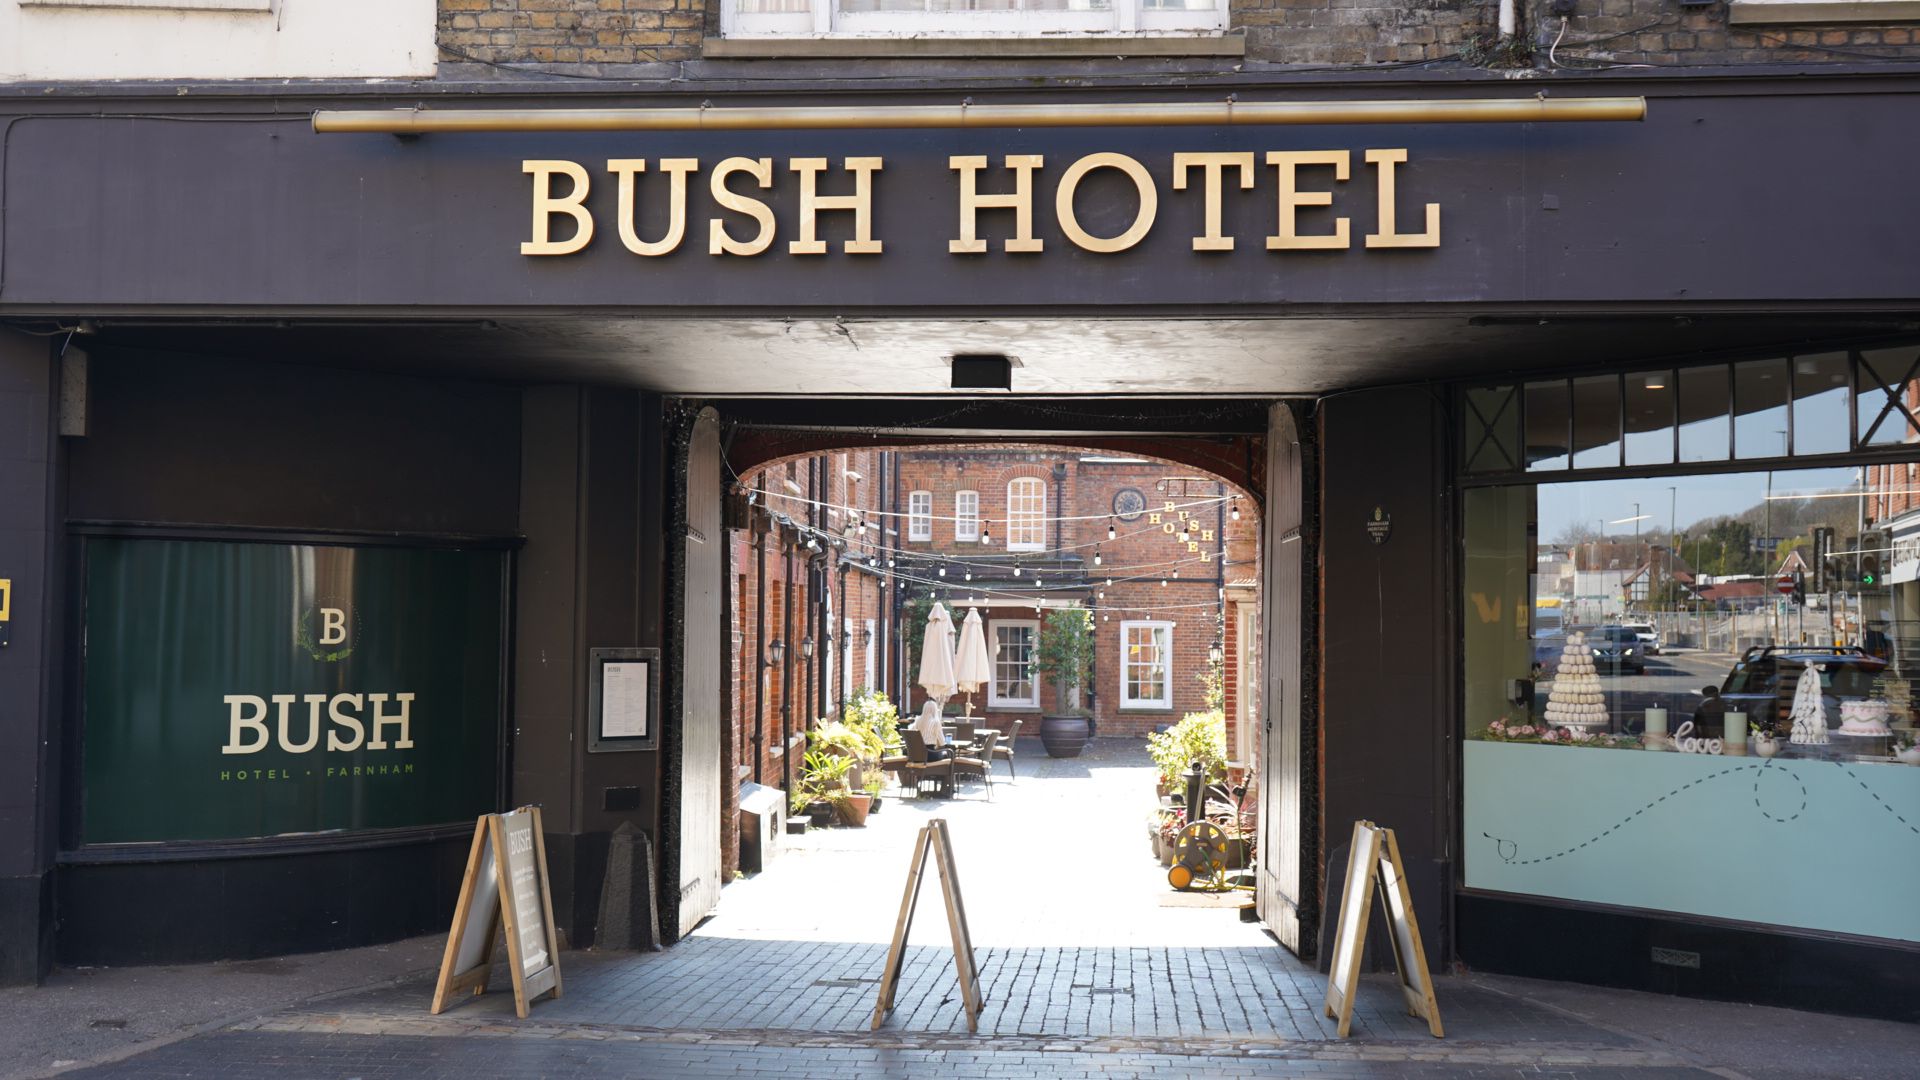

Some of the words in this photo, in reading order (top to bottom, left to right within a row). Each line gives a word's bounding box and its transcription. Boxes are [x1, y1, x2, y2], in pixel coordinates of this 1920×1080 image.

[520, 156, 883, 256] BUSH
[949, 148, 1440, 253] HOTEL
[1149, 513, 1211, 562] HOTEL
[1163, 501, 1214, 541] BUSH
[319, 607, 346, 645] B
[222, 692, 415, 754] BUSH
[1673, 720, 1723, 755] love
[221, 769, 290, 781] HOTEL
[327, 764, 414, 777] FARNHAM
[509, 827, 532, 855] BUSH
